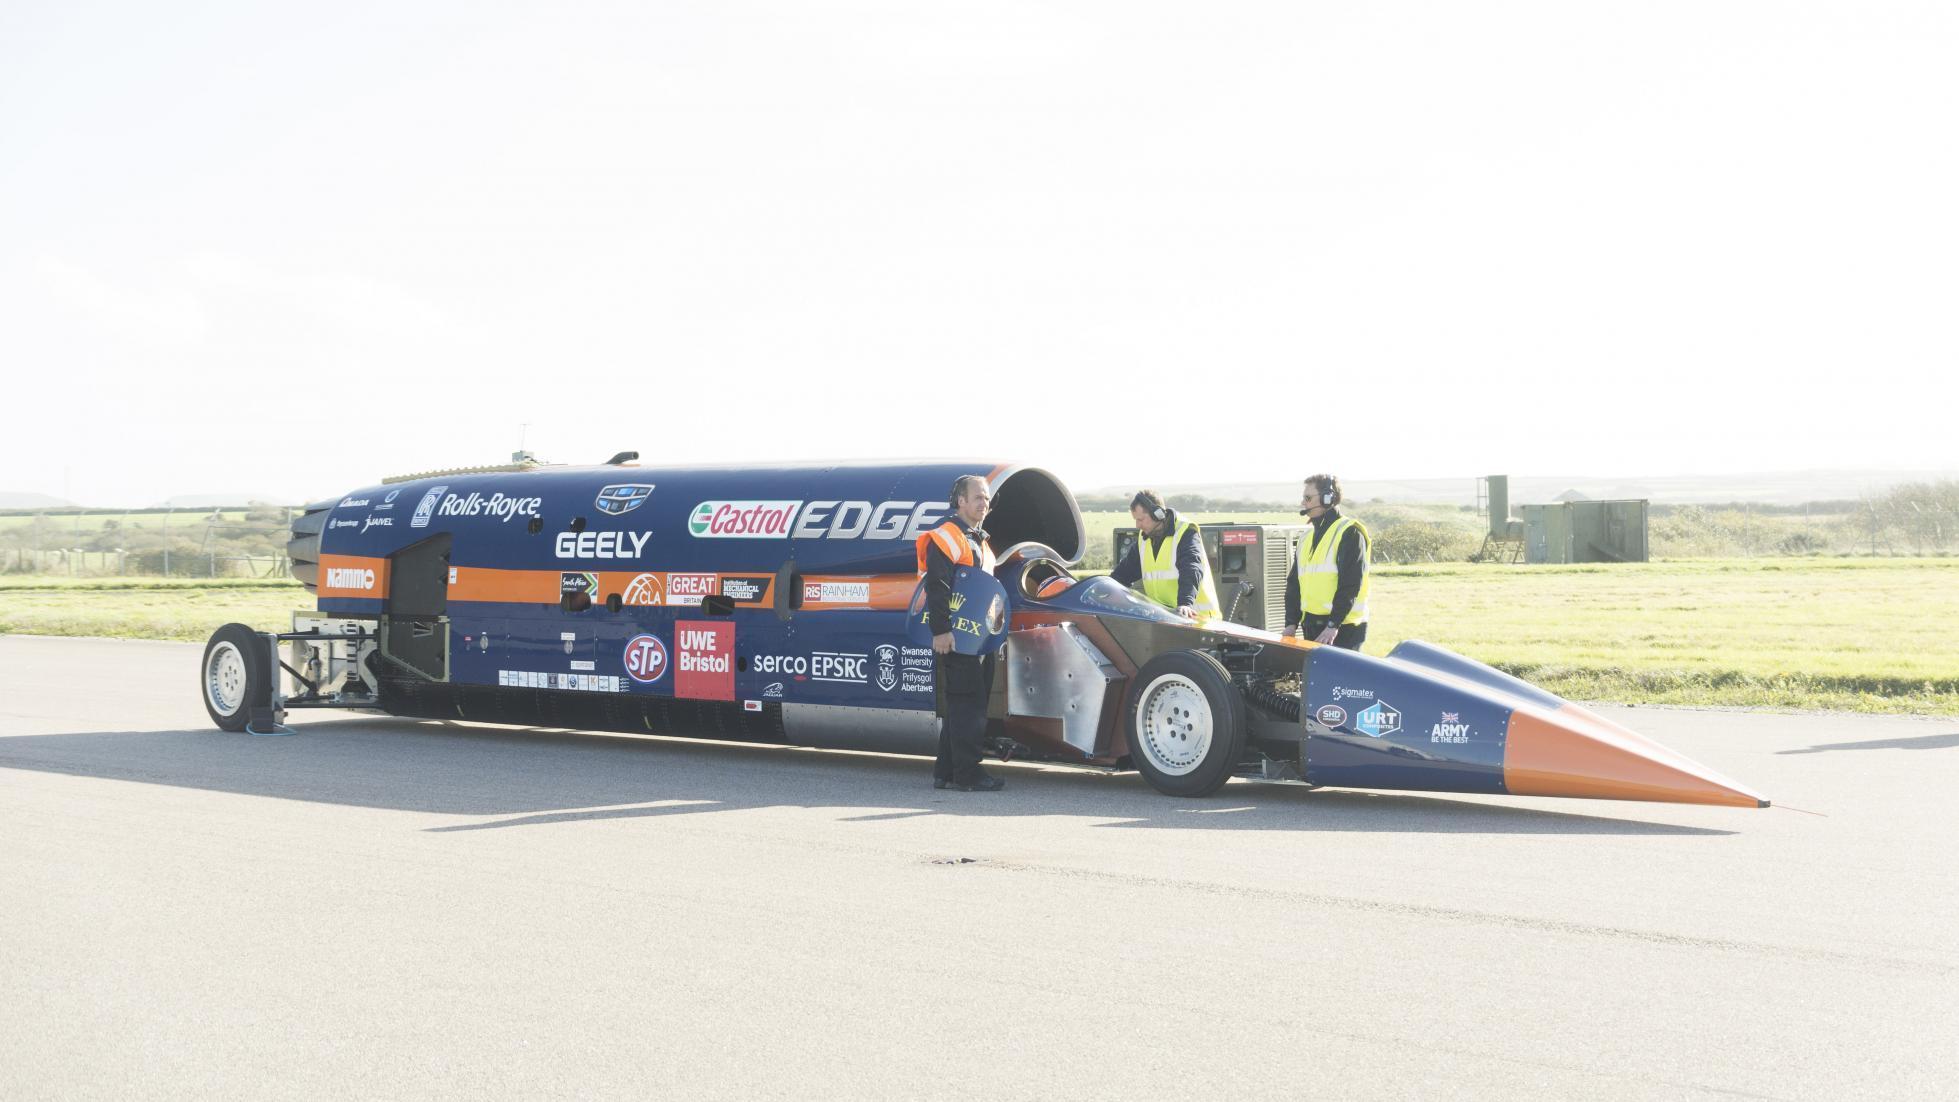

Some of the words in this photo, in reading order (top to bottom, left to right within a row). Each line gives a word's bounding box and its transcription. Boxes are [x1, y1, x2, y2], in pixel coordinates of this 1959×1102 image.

[438, 493, 541, 522] Rolls-Royce
[710, 504, 795, 534] Castrol
[791, 501, 950, 540] EDGE
[555, 531, 653, 559] GEELY
[672, 577, 715, 593] GREAT
[822, 585, 869, 597] RAINHAM
[640, 591, 661, 604] CLA
[920, 611, 982, 636] REX
[680, 631, 716, 650] UWE
[901, 646, 932, 656] Swansea
[629, 641, 662, 675] STP
[680, 653, 729, 672] Bristol
[901, 656, 933, 668] University
[754, 655, 807, 674] serco
[812, 657, 868, 678] EPSRC
[902, 672, 932, 684] Prifysgol
[901, 683, 933, 692] Abertawe
[1341, 688, 1374, 698] sigmatex
[1323, 710, 1340, 718] SHD
[1364, 711, 1397, 724] URT
[1432, 724, 1469, 737] ARMY
